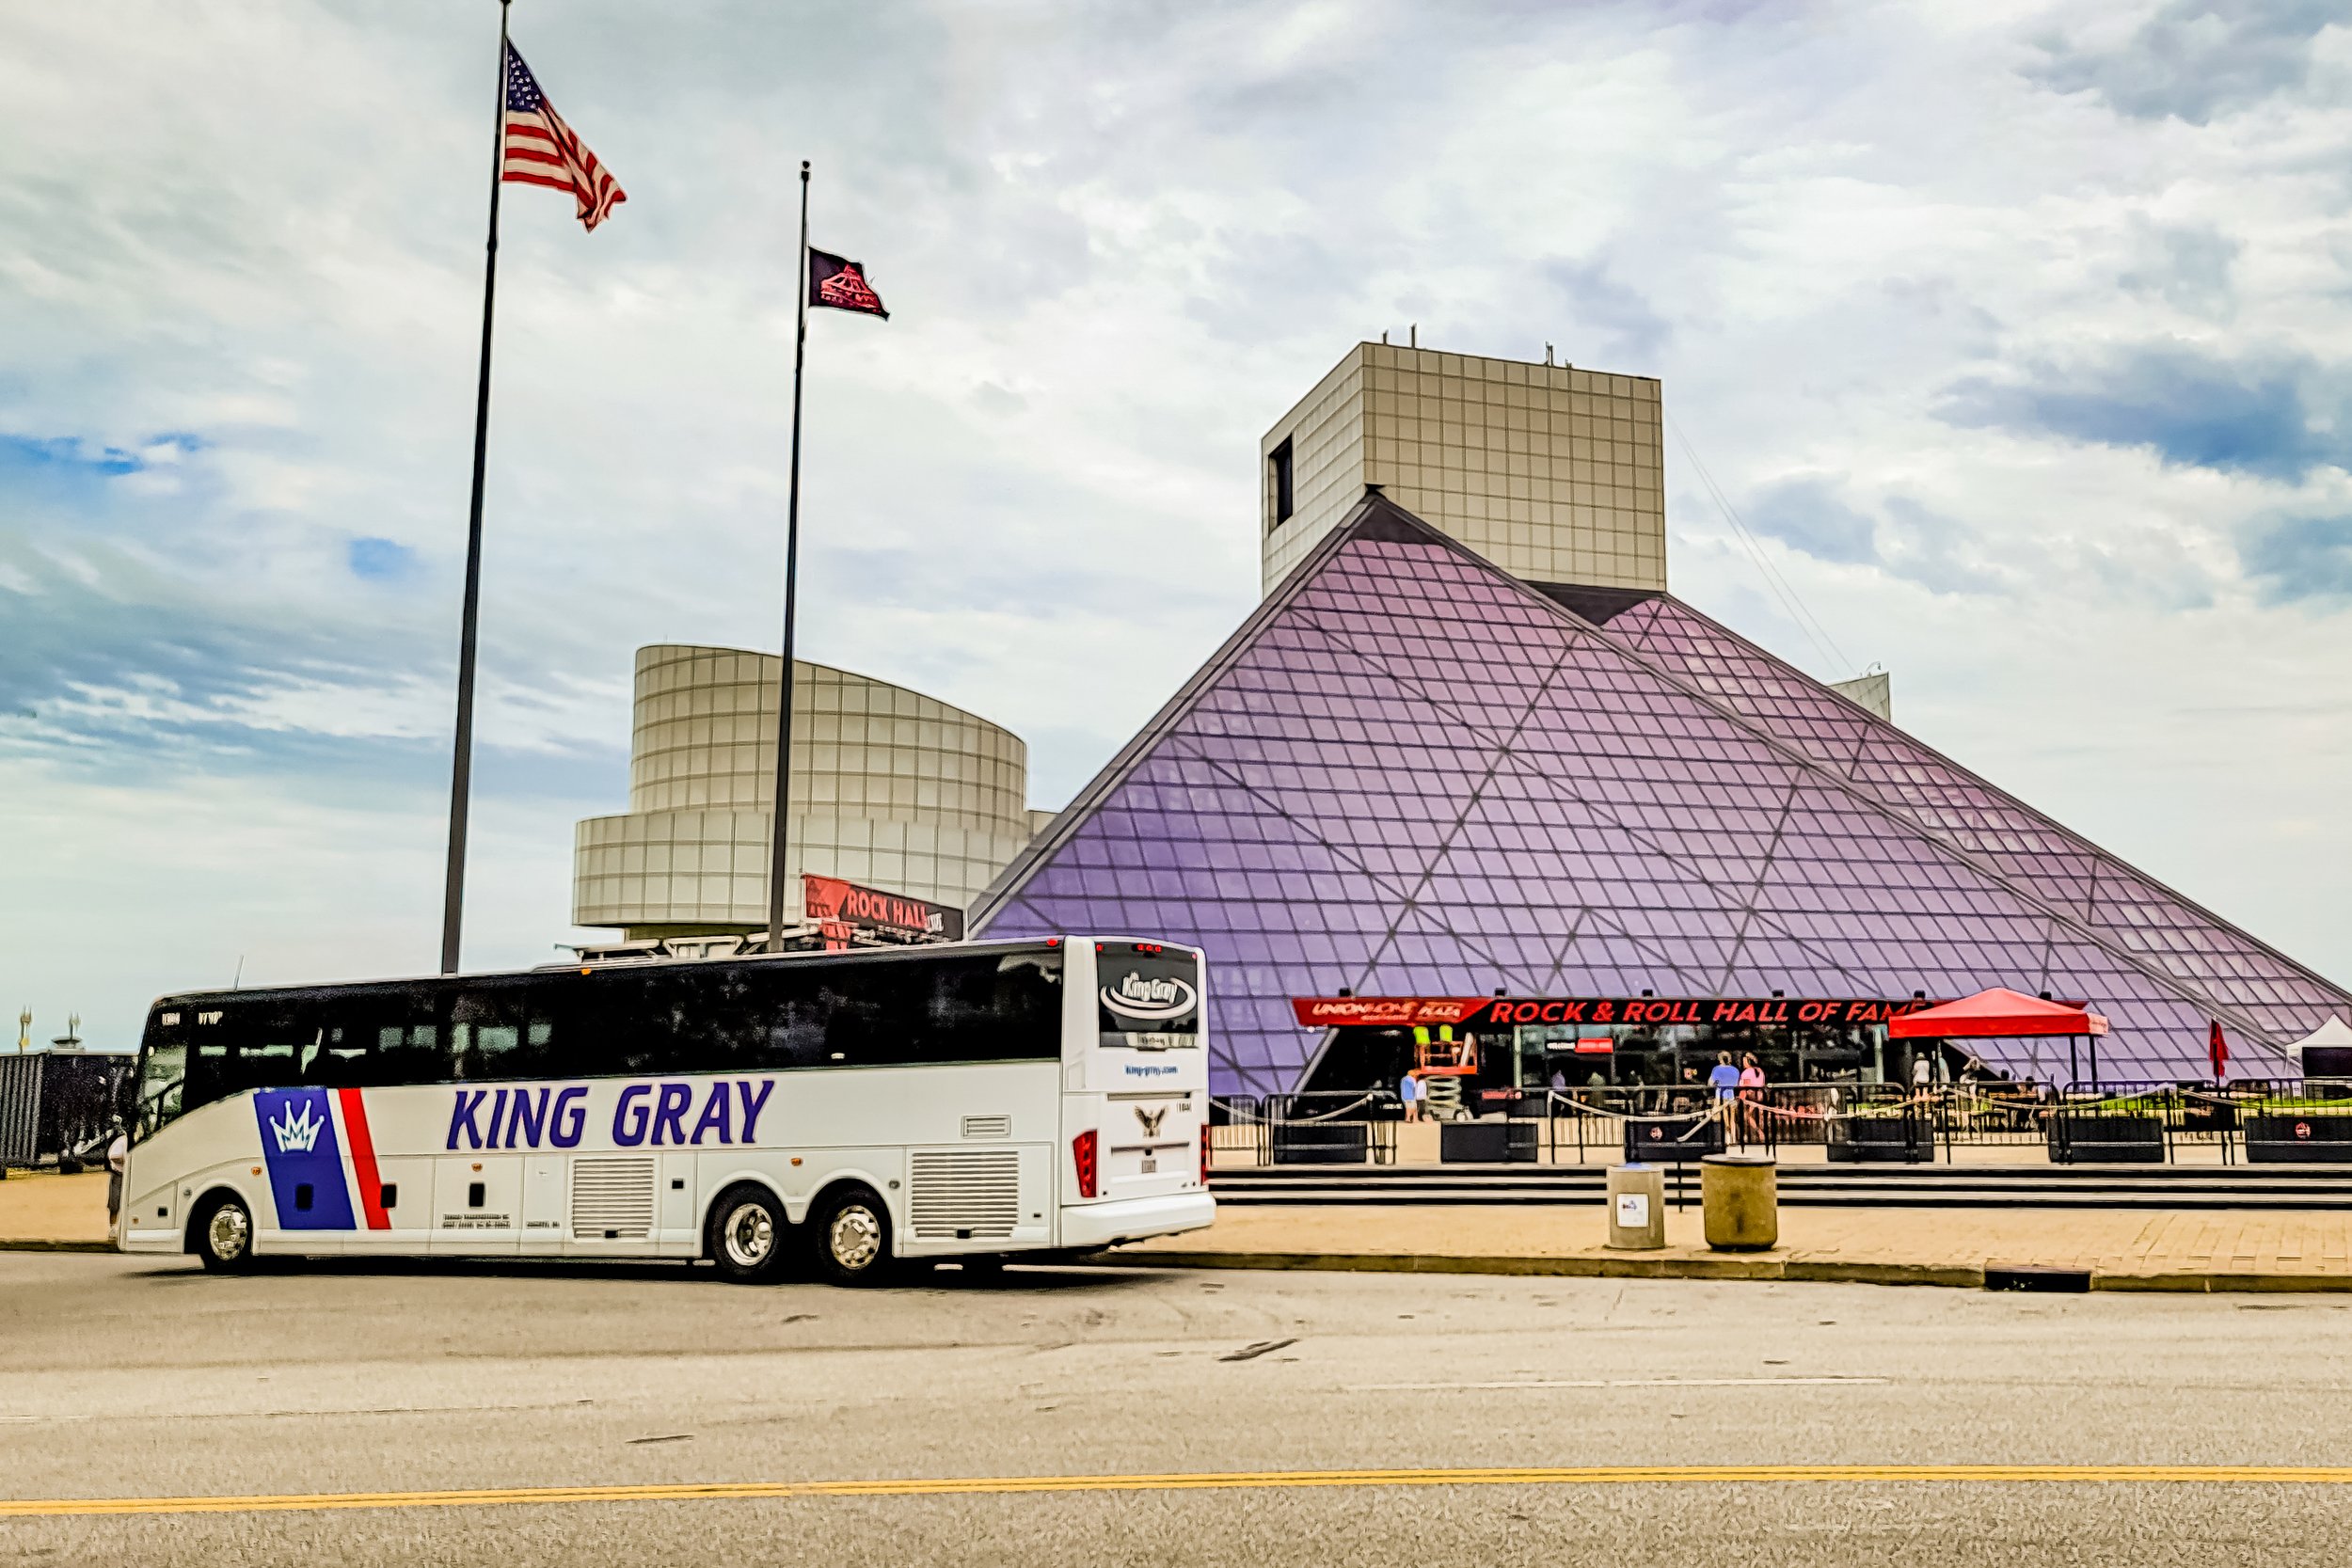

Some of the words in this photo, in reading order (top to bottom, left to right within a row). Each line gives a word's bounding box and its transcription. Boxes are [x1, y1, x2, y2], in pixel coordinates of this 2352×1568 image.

[848, 890, 888, 922] ROCK
[894, 900, 927, 931] HALL
[1490, 1002, 1587, 1023] ROCK
[1592, 1002, 1614, 1022] &
[1623, 1002, 1702, 1022] ROLL
[1712, 1003, 1788, 1022] HALL
[1798, 1003, 1841, 1022] OF
[446, 1085, 589, 1150] KING
[612, 1080, 775, 1147] GRAY
